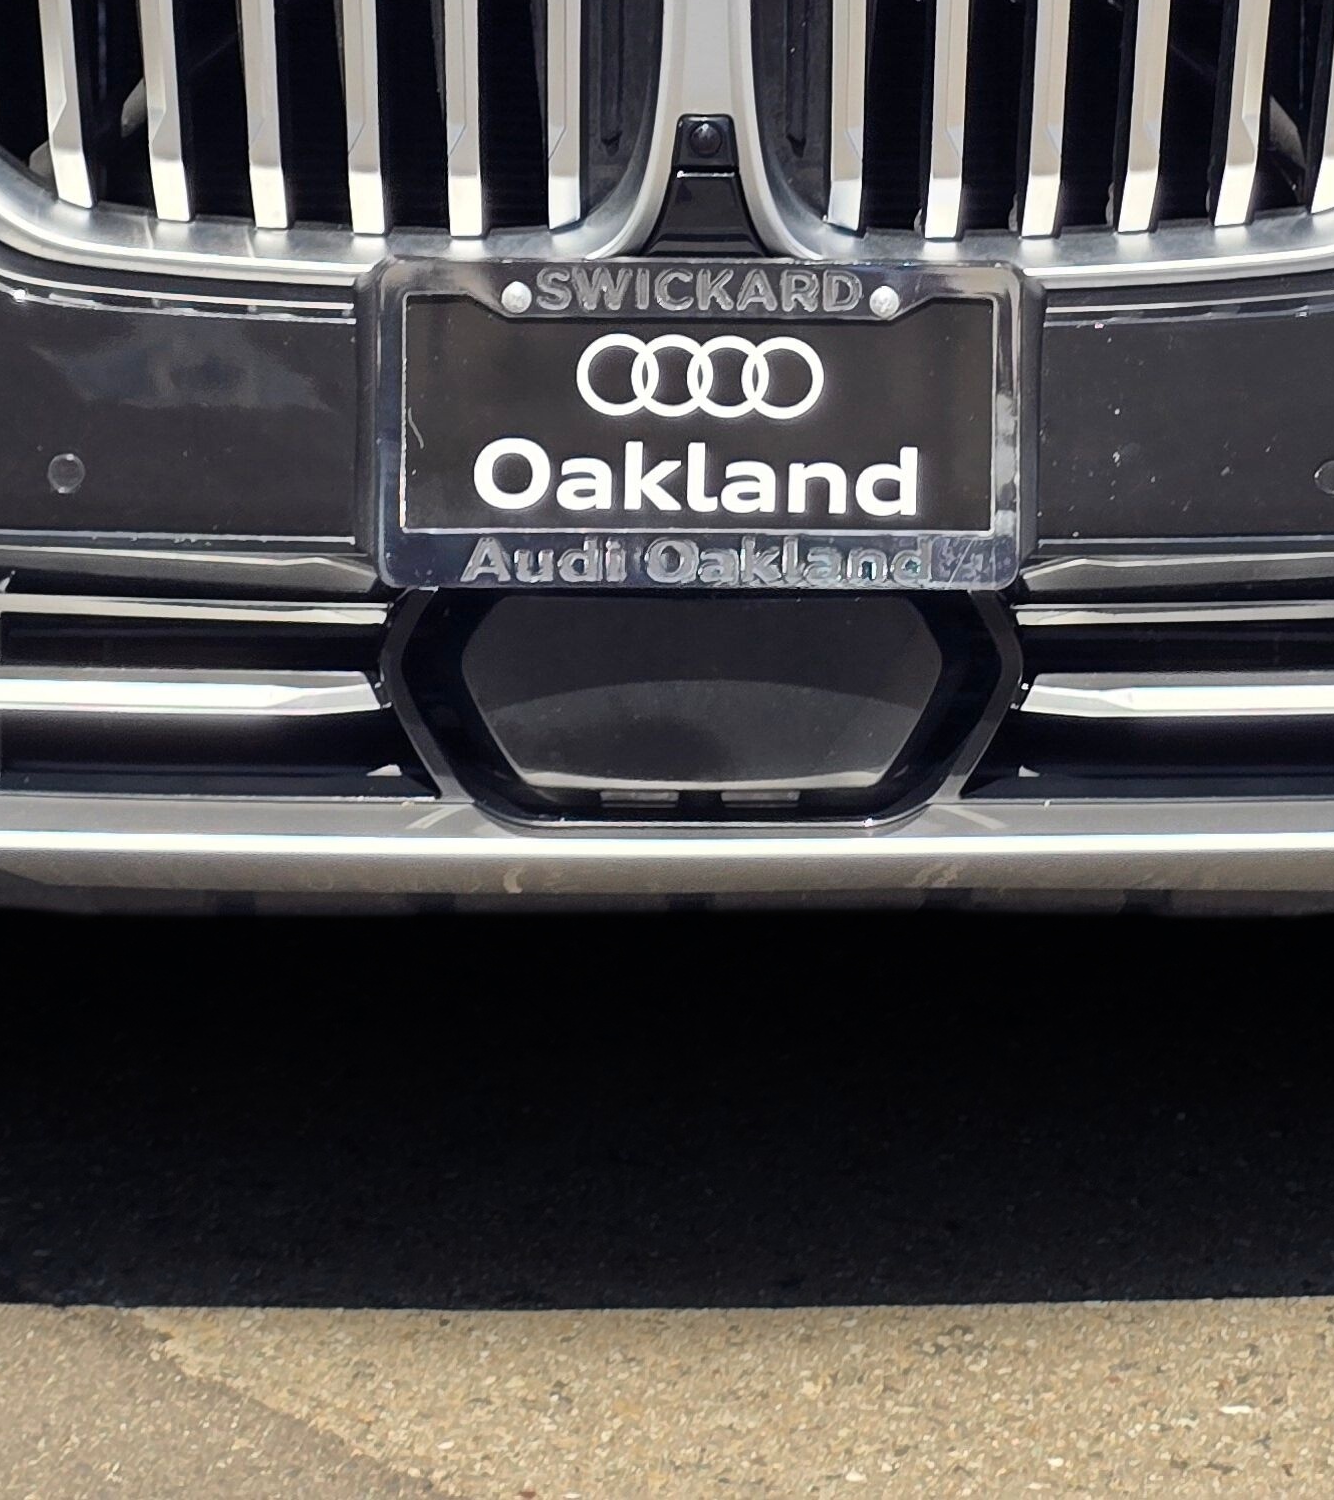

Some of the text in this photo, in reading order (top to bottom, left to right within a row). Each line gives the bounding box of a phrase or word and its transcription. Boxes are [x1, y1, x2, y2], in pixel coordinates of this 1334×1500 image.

[535, 268, 864, 313] SWICKARD
[472, 437, 919, 517] Oakland
[459, 535, 934, 586] Audi Oakland
